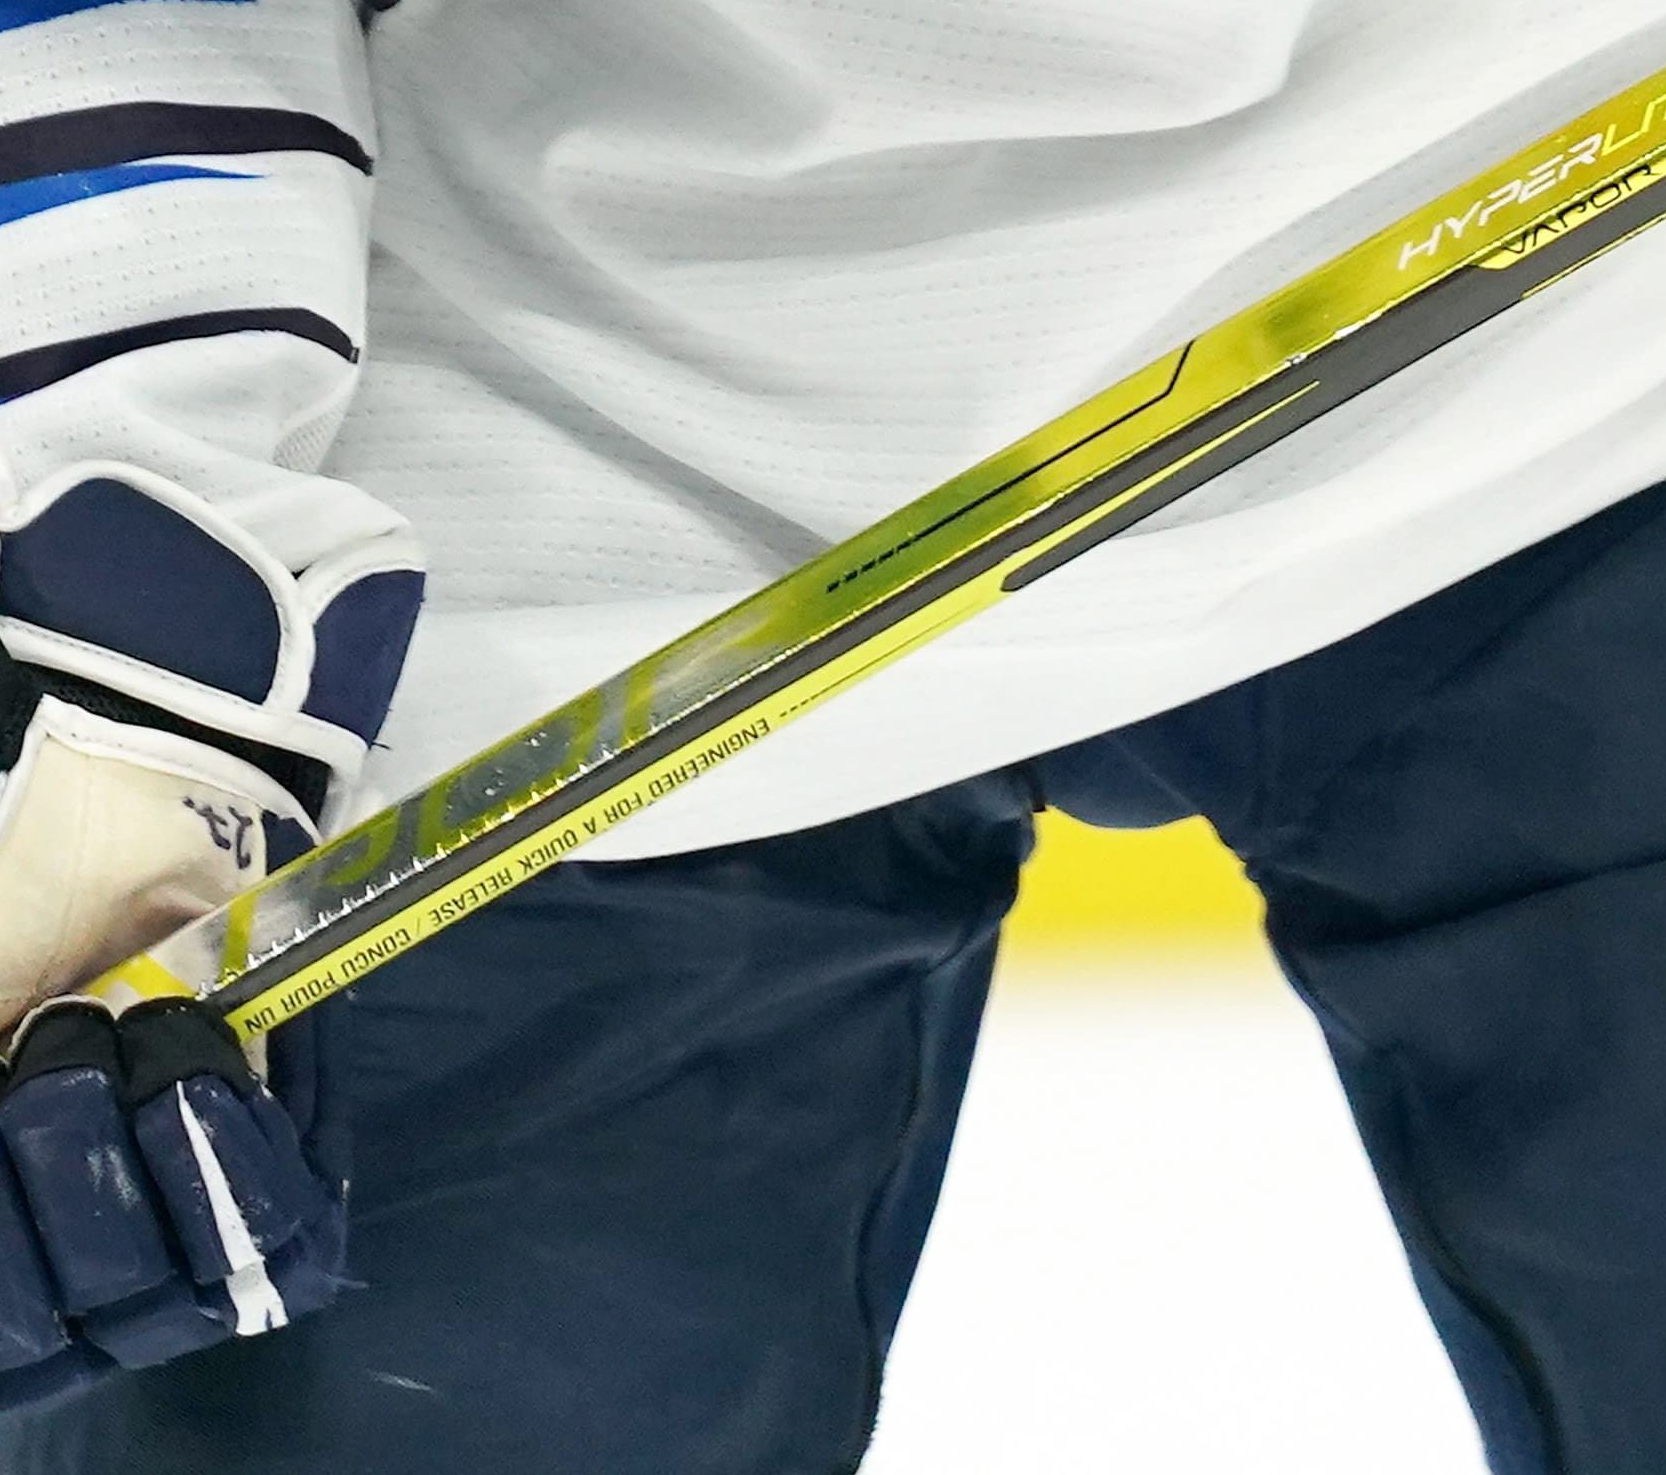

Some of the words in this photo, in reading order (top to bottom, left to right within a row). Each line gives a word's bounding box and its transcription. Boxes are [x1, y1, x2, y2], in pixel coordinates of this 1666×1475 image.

[1499, 162, 1661, 255] VAPOR
[648, 717, 770, 799] ENGINEERED
[583, 818, 598, 837] A
[603, 791, 644, 824] FOR
[519, 830, 579, 873] QUICK
[432, 867, 514, 927] RELEASE
[280, 967, 338, 1013] POUR
[244, 1009, 278, 1035] UN
